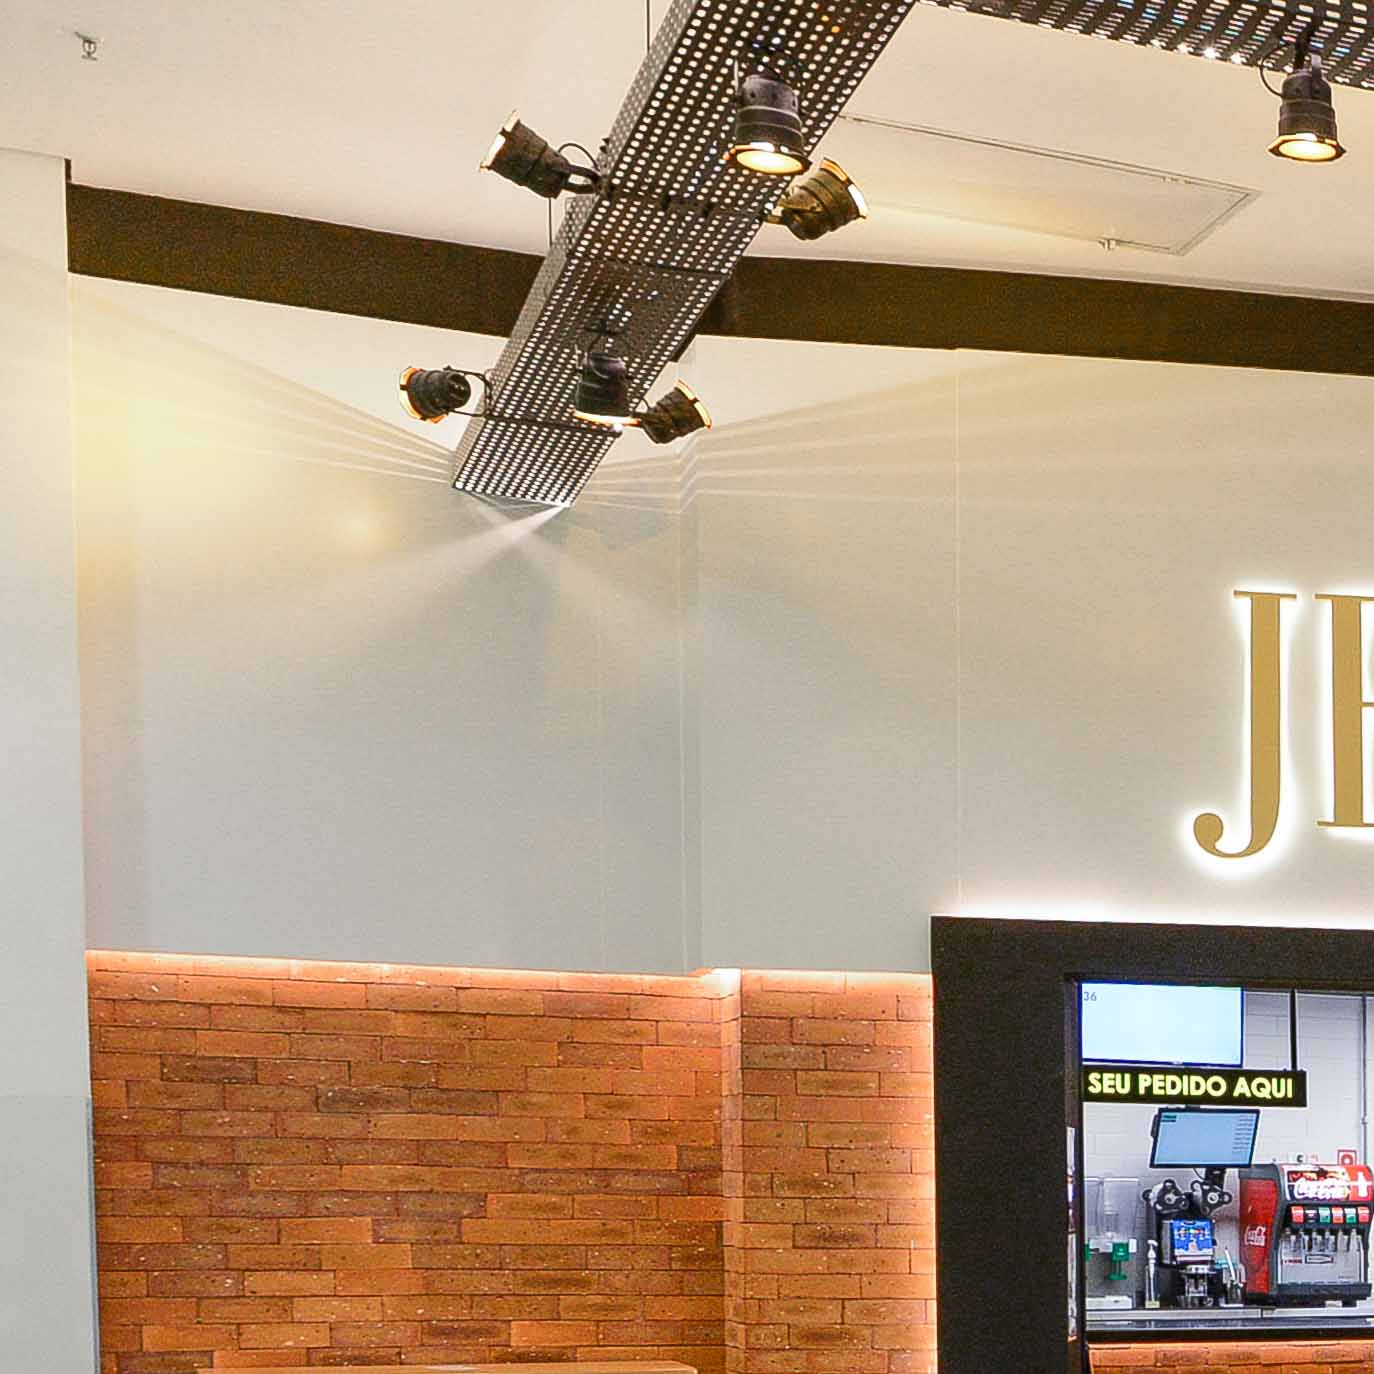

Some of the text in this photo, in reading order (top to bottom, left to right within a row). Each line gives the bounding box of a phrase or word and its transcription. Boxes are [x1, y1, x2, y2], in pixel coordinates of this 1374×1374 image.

[1087, 1073, 1294, 1100] SEU PEDIDO AQUI
